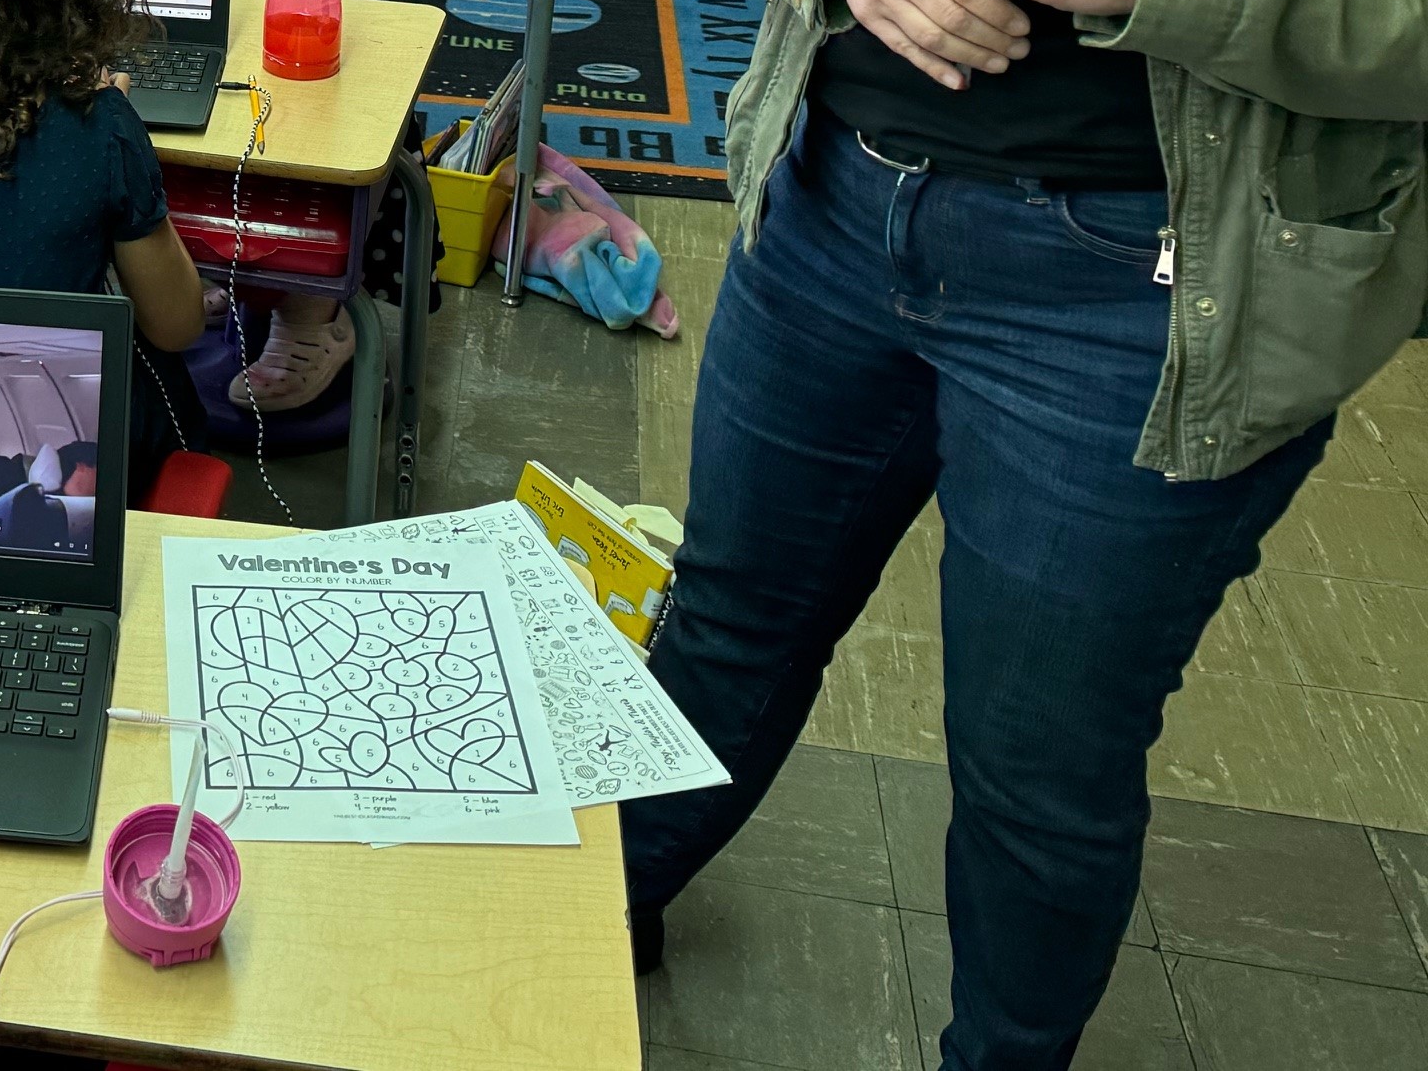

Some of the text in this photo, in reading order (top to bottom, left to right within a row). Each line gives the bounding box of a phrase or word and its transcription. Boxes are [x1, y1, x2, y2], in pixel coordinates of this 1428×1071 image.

[557, 83, 647, 104] Pluto
[217, 554, 451, 579] Valentine's Day
[281, 576, 322, 584] COLOR
[345, 578, 392, 586] NUMBER
